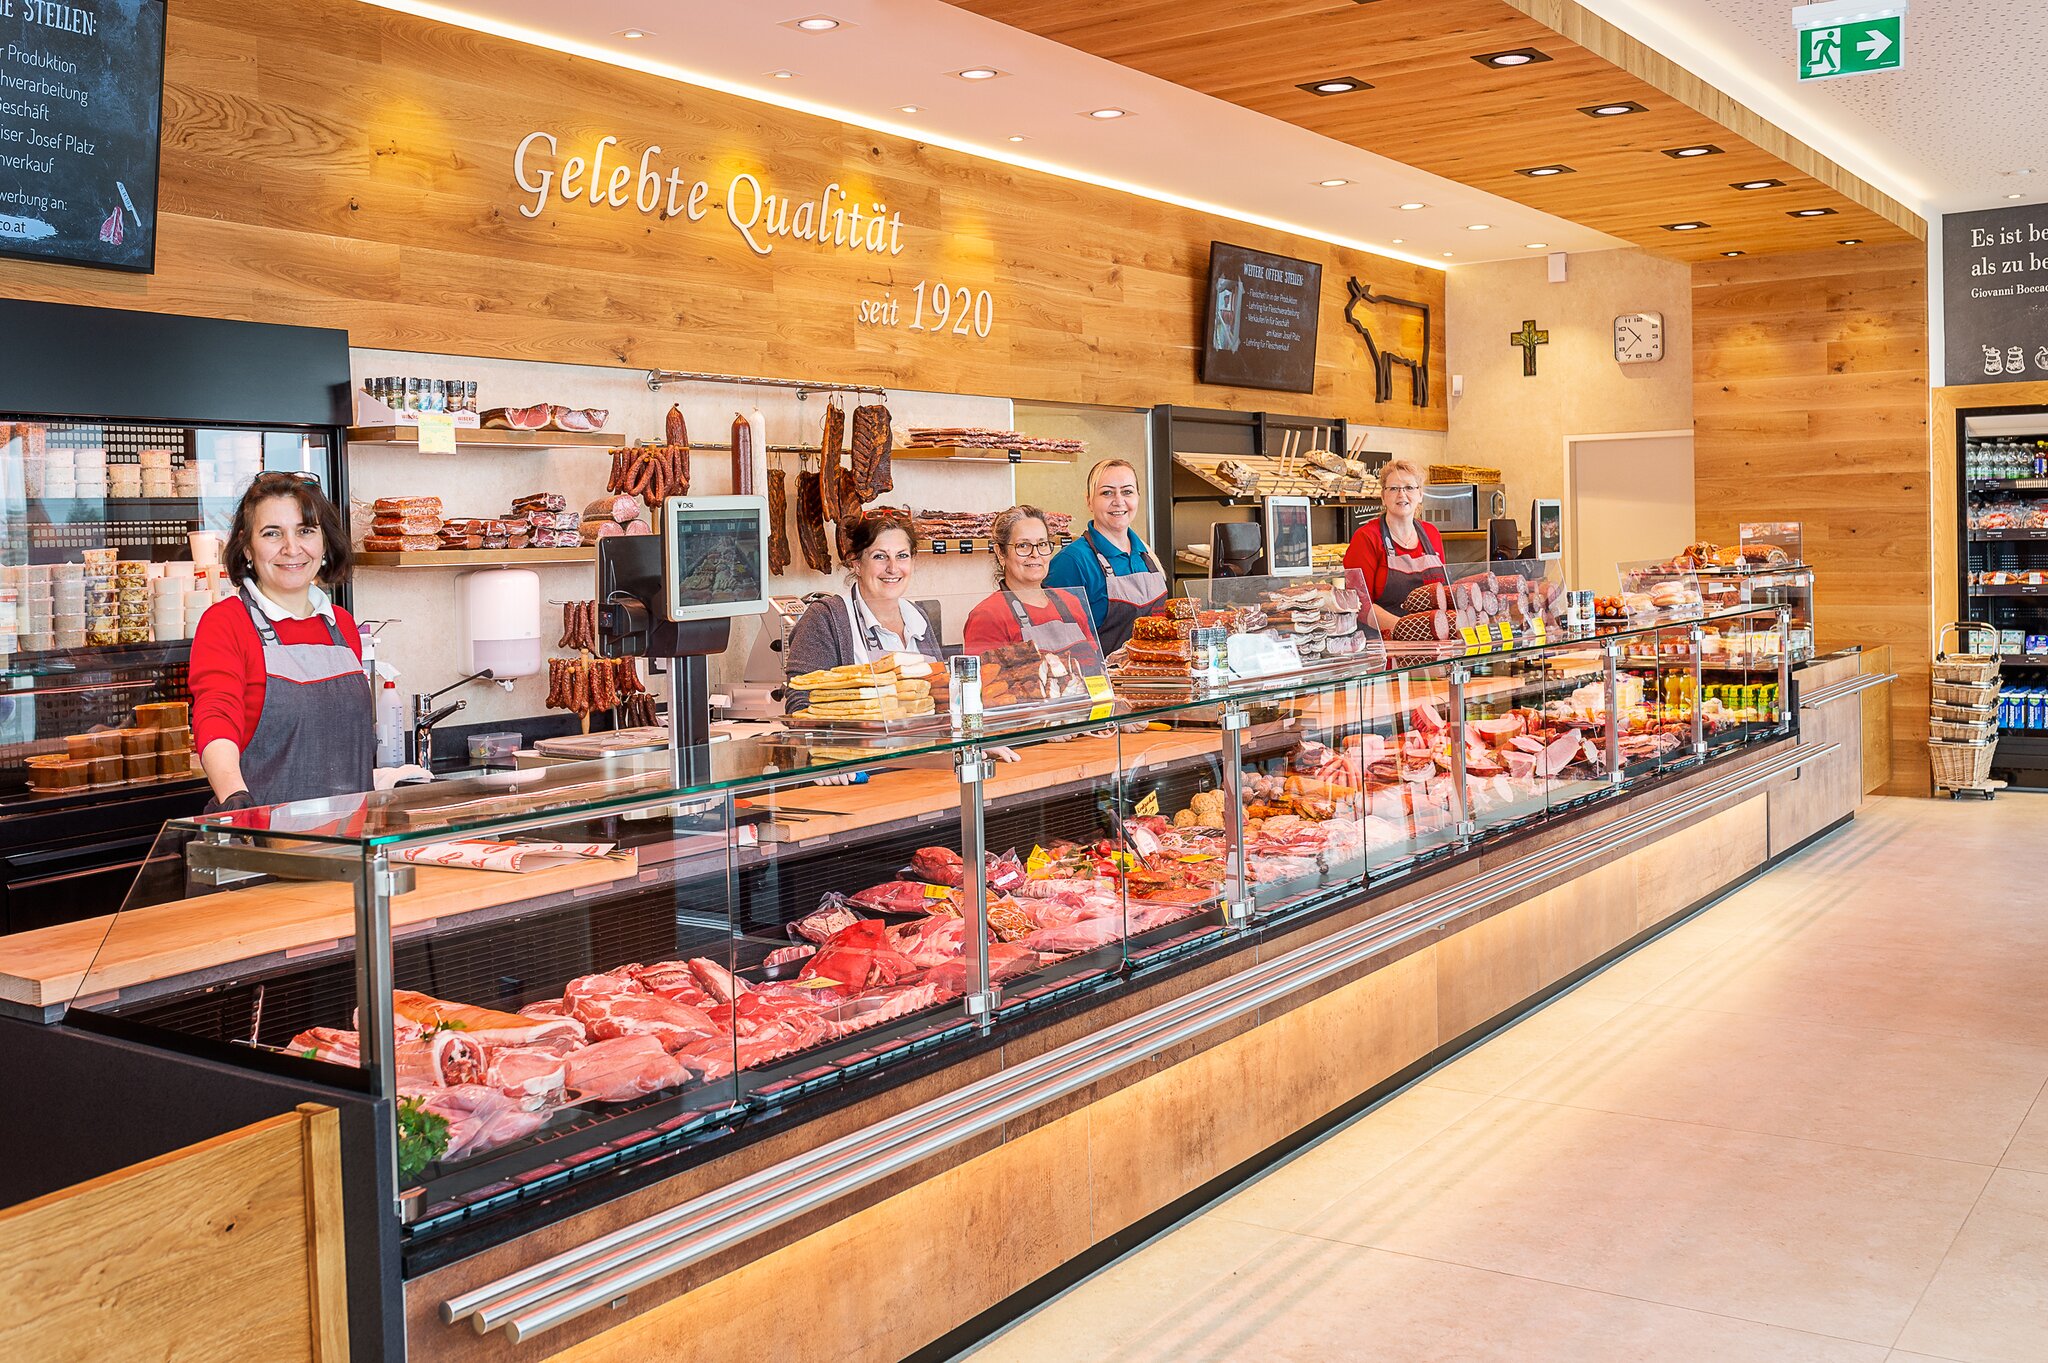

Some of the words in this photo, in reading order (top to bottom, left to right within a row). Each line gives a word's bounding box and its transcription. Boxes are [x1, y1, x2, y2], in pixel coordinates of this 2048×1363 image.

[23, 0, 97, 36] STELLEN:
[8, 44, 77, 74] Produktion
[0, 69, 89, 107] hverarbeitung
[27, 128, 63, 150] Josef
[65, 134, 95, 156] Platz
[0, 188, 49, 212] werbung
[50, 197, 68, 211] an:
[513, 131, 708, 221] Gelebte
[726, 173, 905, 257] Qualität
[1970, 228, 1995, 248] Es
[1999, 226, 2023, 245] ist
[2028, 223, 2048, 242] be
[1971, 256, 1997, 276] als
[2001, 260, 2024, 274] zu
[2029, 252, 2048, 271] be
[1971, 284, 2014, 299] Giovanni
[857, 291, 899, 327] seit
[908, 279, 994, 339] 1920
